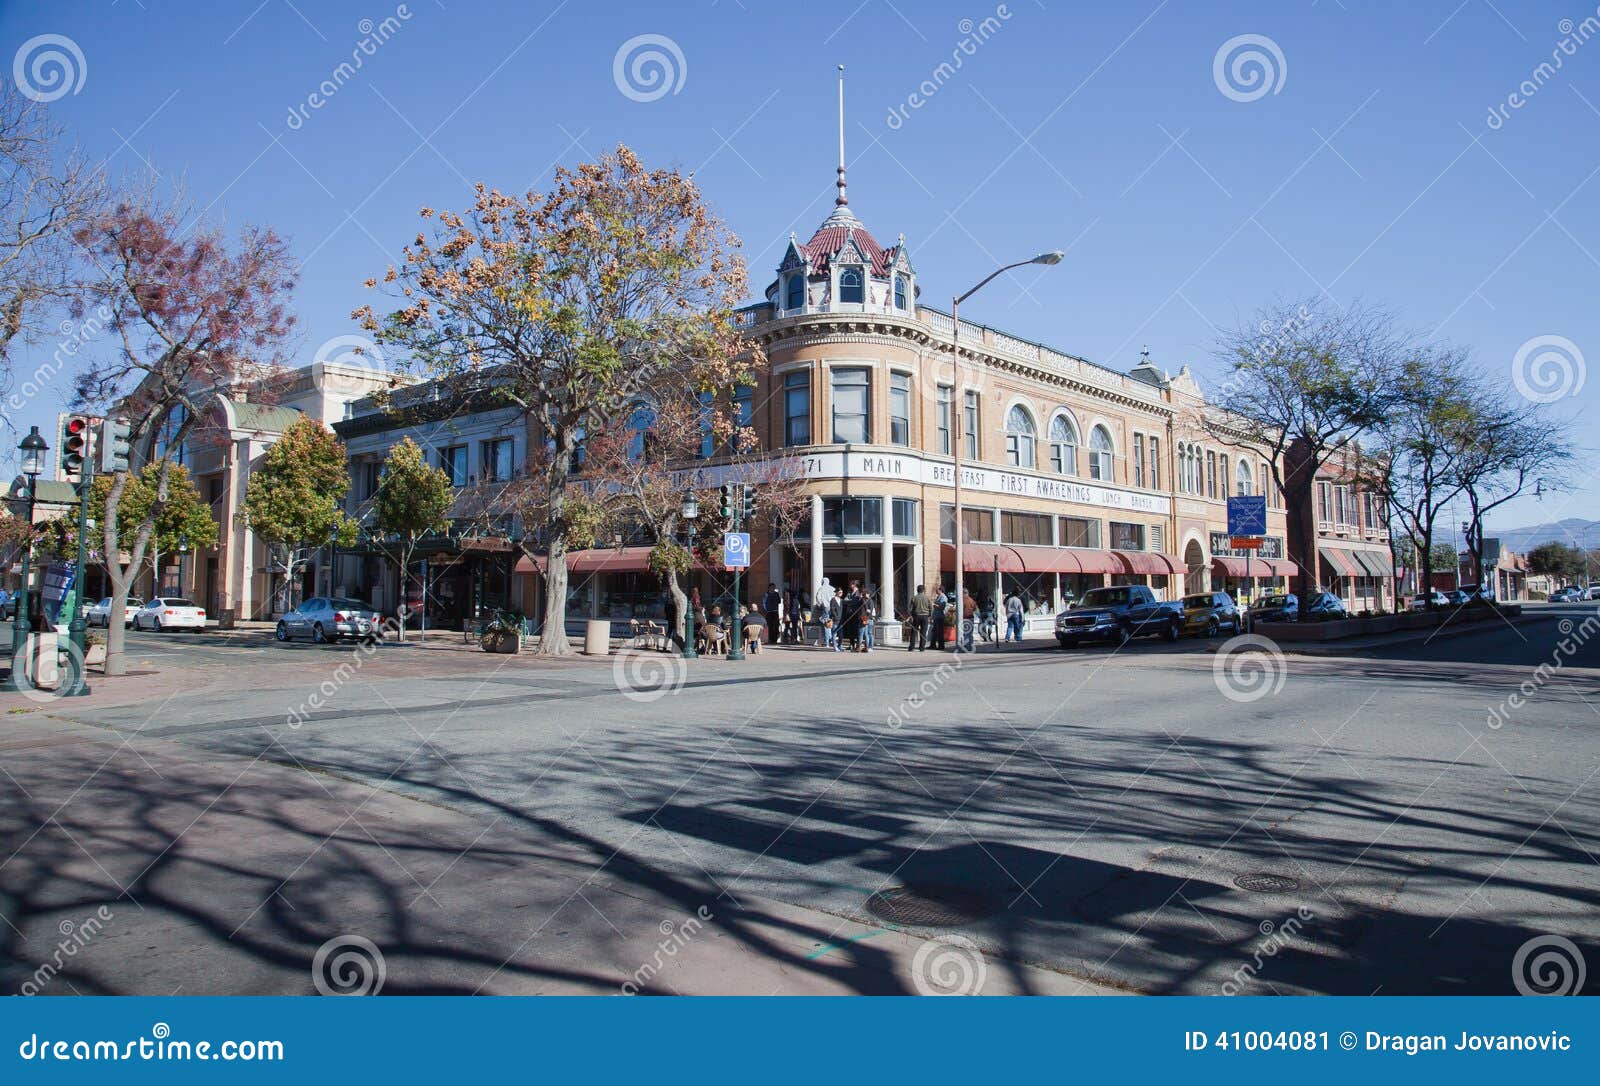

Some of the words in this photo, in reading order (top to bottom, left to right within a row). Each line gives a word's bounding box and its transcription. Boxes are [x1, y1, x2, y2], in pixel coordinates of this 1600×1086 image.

[863, 457, 901, 474] MAIN
[1001, 474, 1028, 492] FIRST
[1036, 480, 1090, 502] AWAKENINGS
